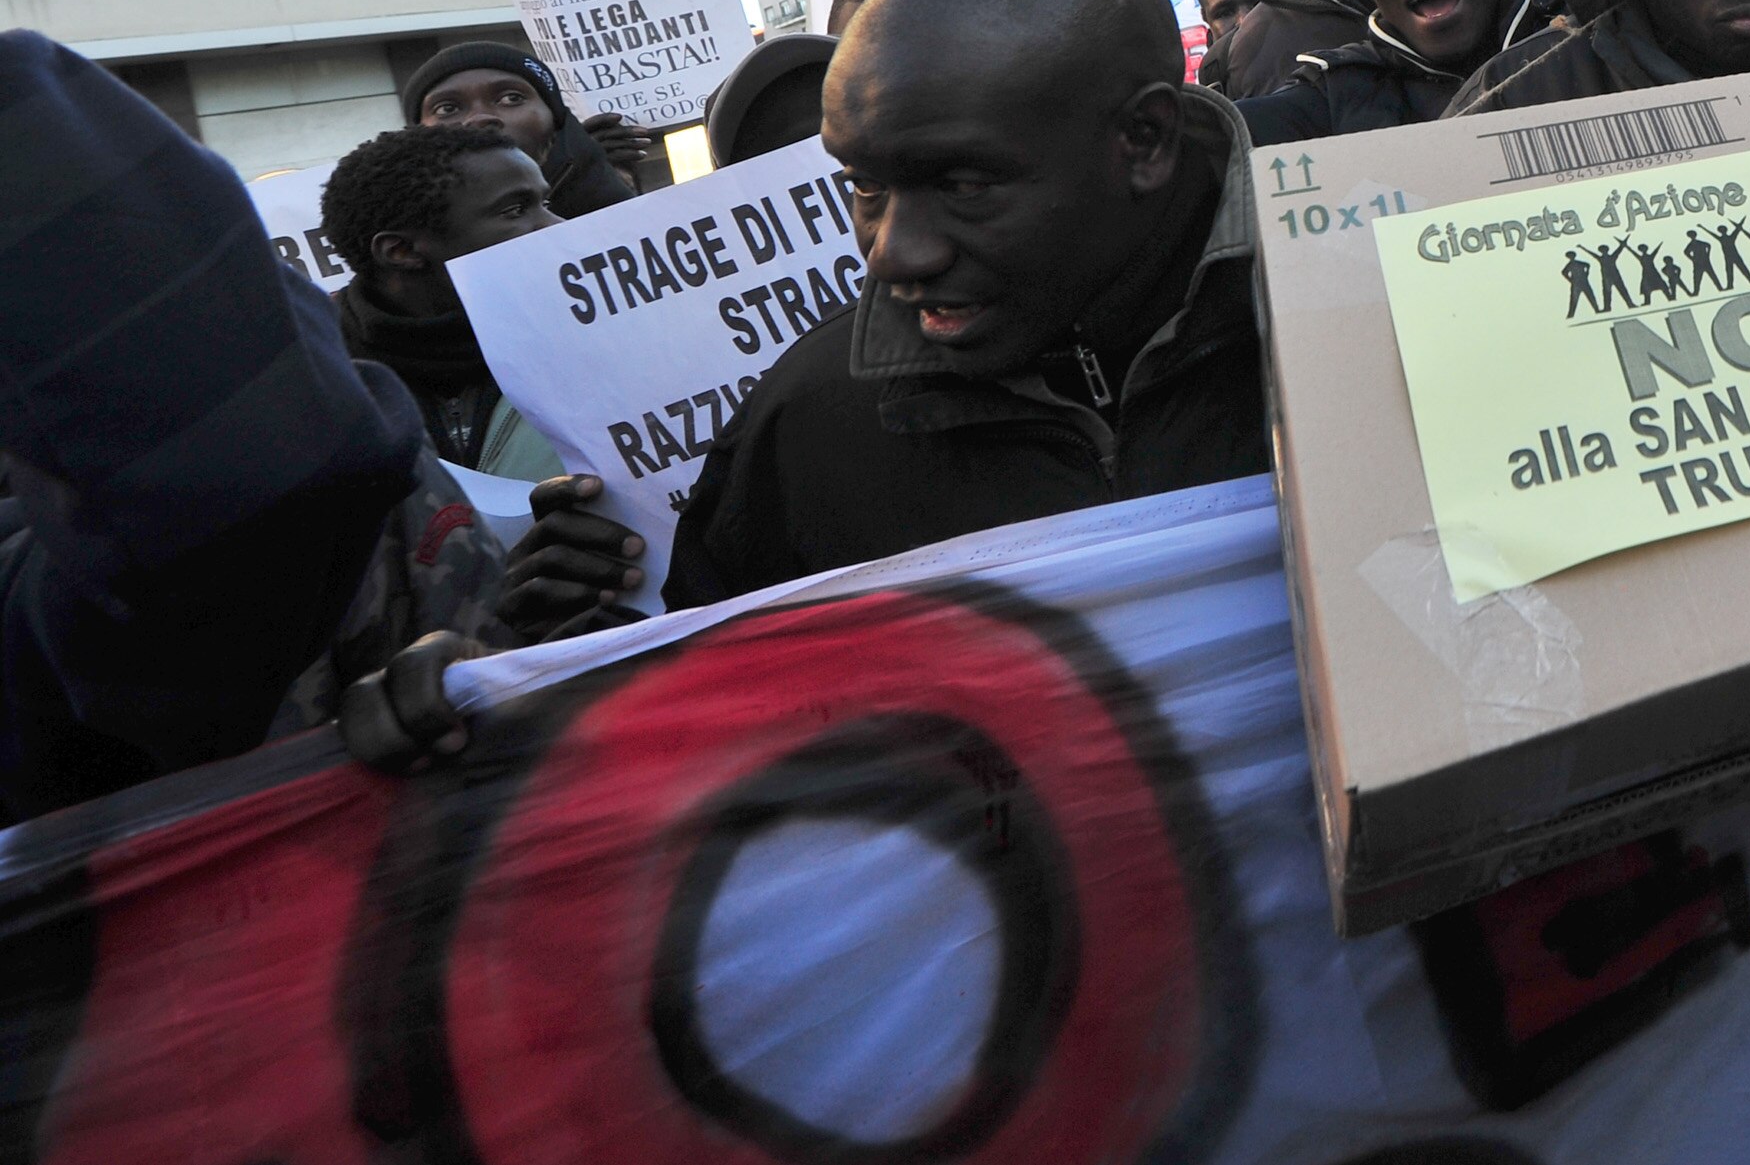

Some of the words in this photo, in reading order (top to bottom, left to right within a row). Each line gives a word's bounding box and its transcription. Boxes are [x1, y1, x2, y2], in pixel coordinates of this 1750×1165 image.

[563, 9, 709, 63] MANDANTI
[588, 36, 721, 91] BASTA!!
[654, 81, 685, 102] SE
[1556, 150, 1695, 184] 05413149893795
[1277, 203, 1330, 239] 10
[1417, 205, 1585, 264] Giornata
[559, 215, 738, 325] STRAGE
[731, 196, 795, 266] DI
[1507, 425, 1618, 490] alla
